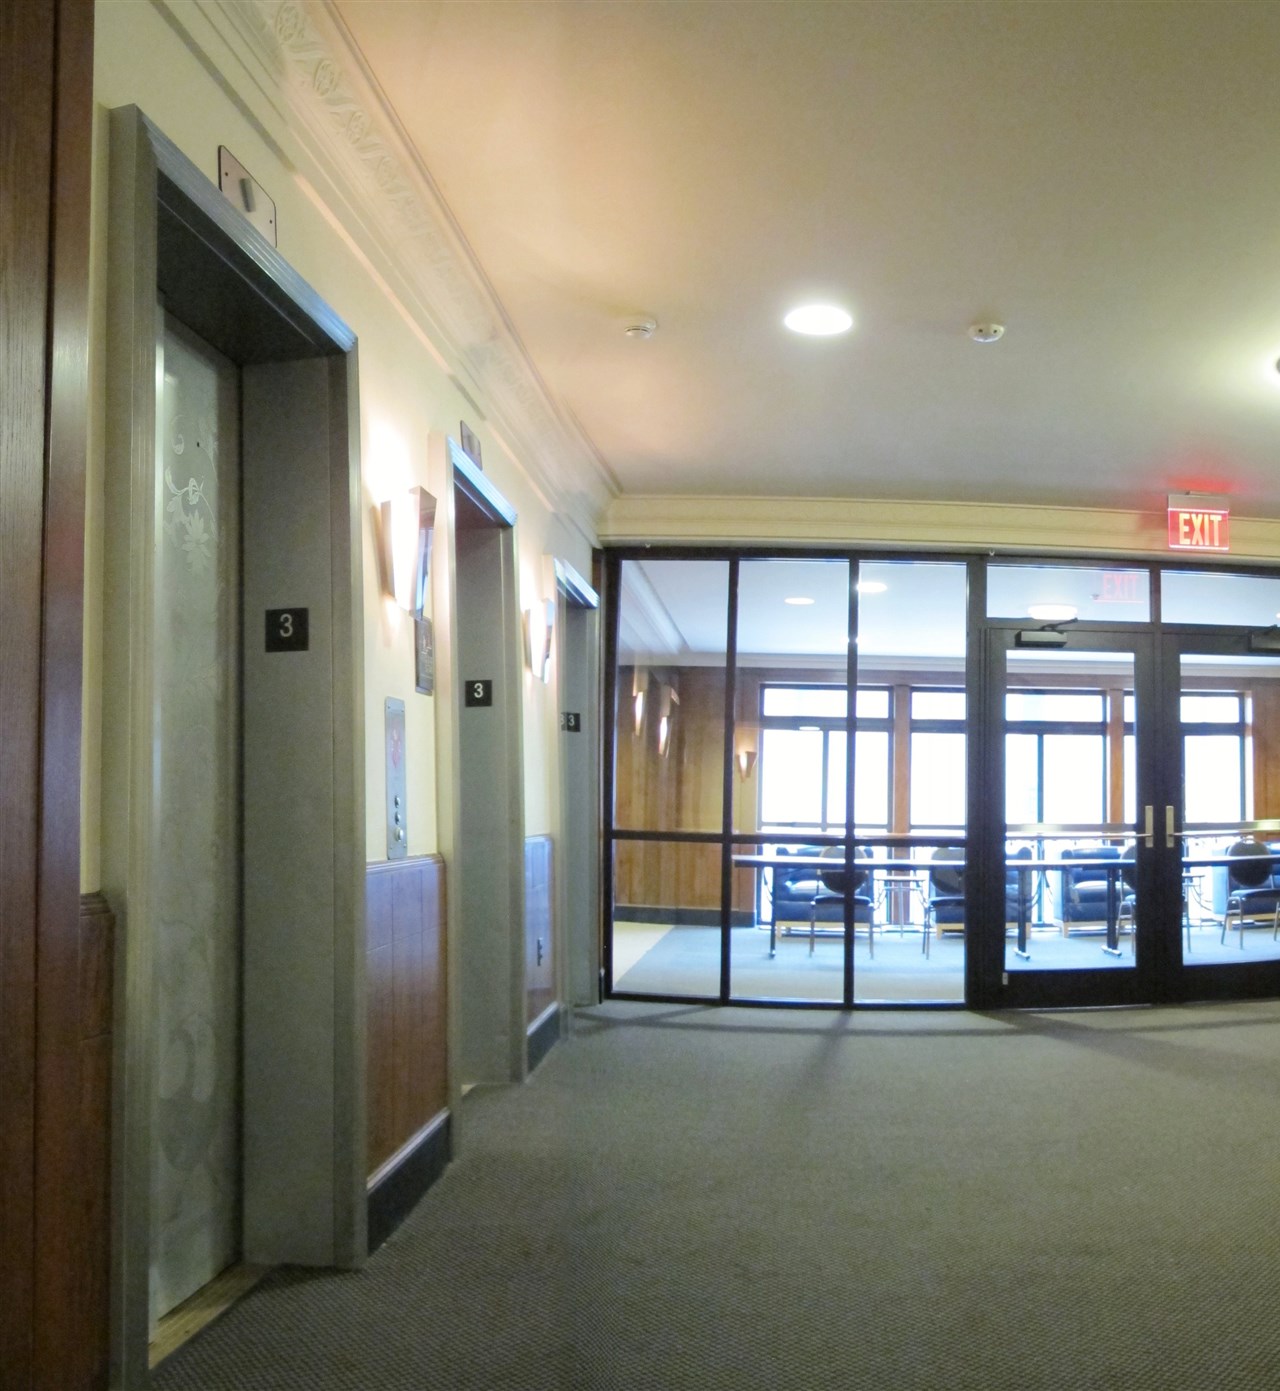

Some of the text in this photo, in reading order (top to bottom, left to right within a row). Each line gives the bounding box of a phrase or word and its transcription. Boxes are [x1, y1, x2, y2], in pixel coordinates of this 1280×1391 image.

[1179, 512, 1223, 547] EXIT
[1103, 573, 1137, 601] EXIT
[280, 613, 294, 638] 3
[474, 682, 484, 699] 3
[568, 714, 576, 727] 3
